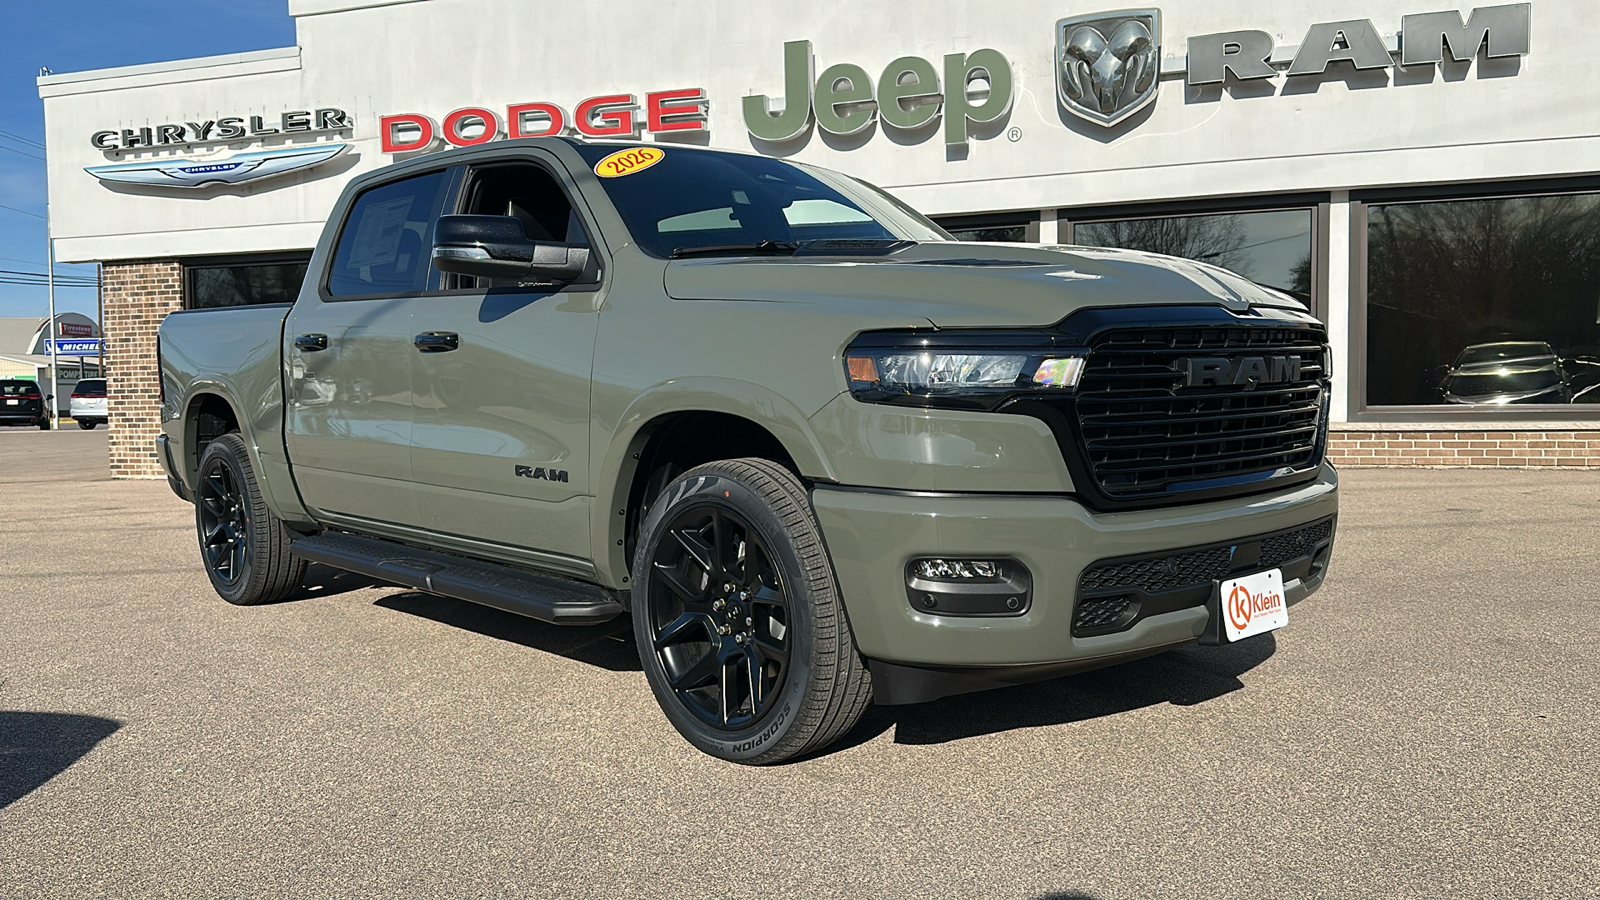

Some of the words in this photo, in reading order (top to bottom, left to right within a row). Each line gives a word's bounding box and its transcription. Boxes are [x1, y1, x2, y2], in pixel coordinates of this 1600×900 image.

[1187, 3, 1531, 85] RAM
[742, 40, 1013, 145] Jeep
[90, 108, 351, 151] CHRYSLER
[379, 88, 706, 153] DODGE
[184, 163, 236, 173] CHRYSLER
[606, 149, 654, 174] 2026
[62, 343, 106, 351] MICHEL
[1186, 355, 1301, 387] RAM
[514, 464, 569, 483] RAM
[1252, 590, 1281, 613] Klein
[732, 702, 791, 753] SCORPION
